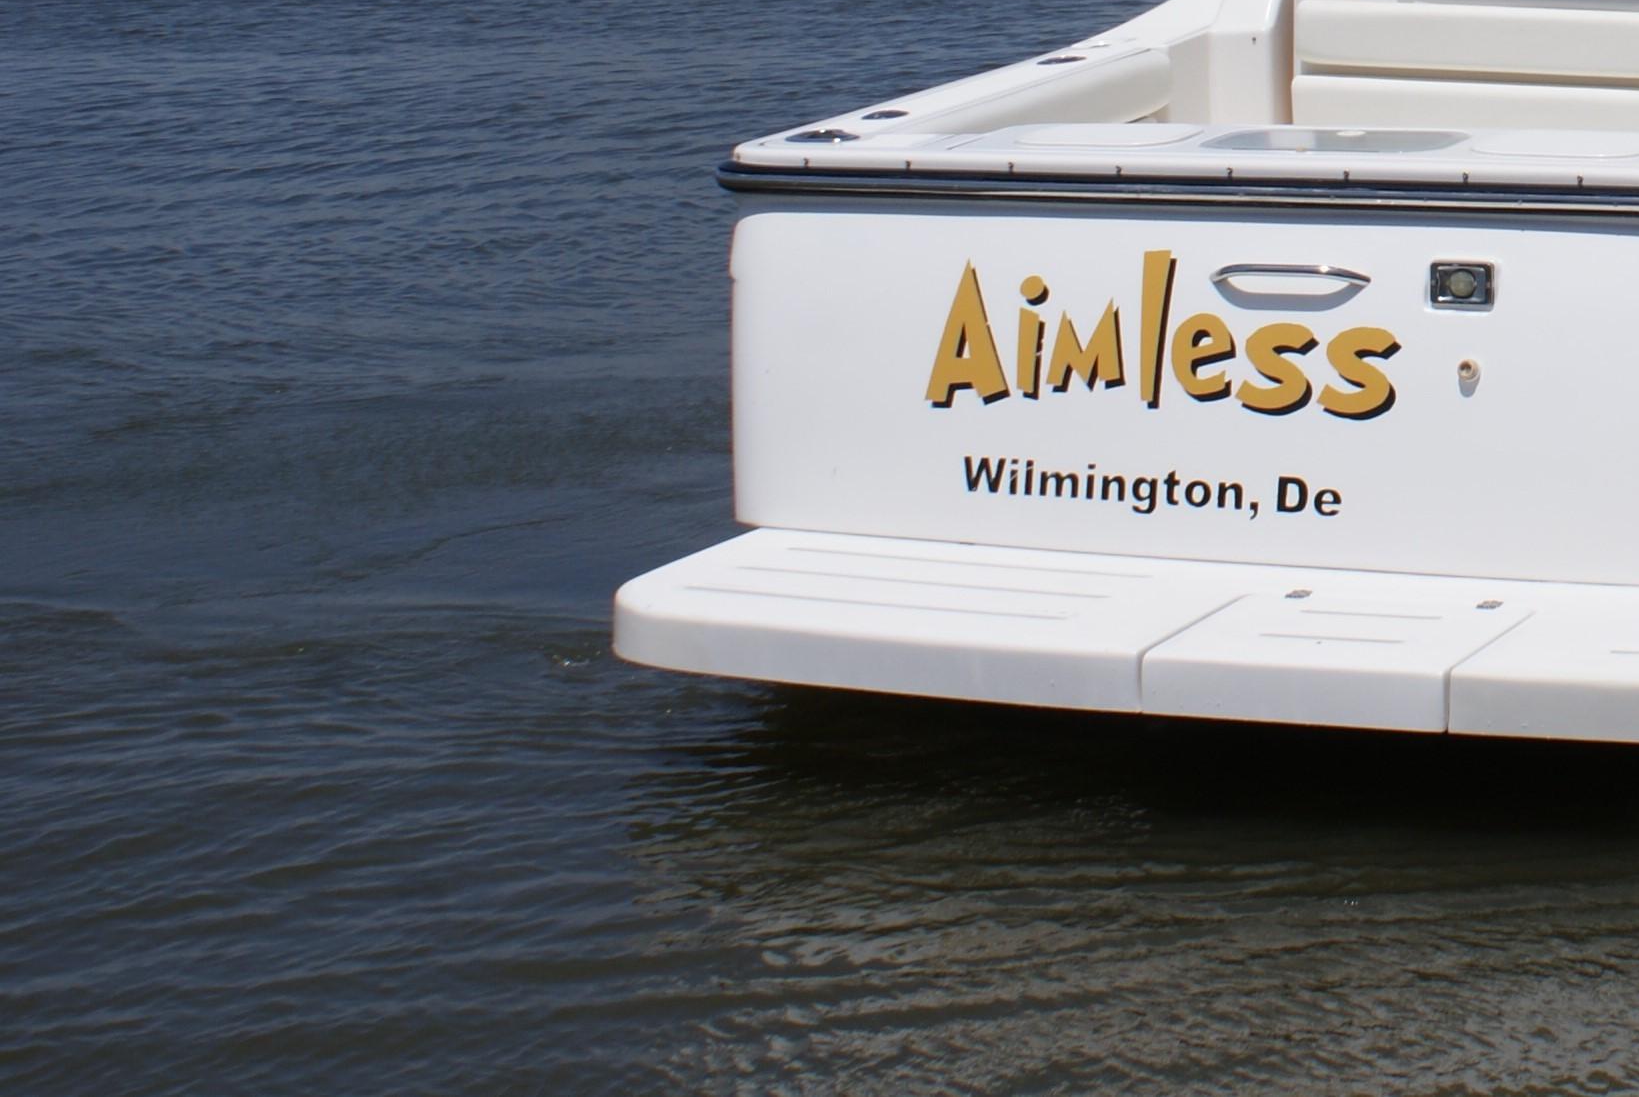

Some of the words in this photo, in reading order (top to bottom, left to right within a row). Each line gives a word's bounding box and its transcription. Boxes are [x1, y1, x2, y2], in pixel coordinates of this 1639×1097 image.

[925, 250, 1402, 420] Aimless
[964, 456, 1259, 520] Wilmington,
[1276, 476, 1342, 516] De
